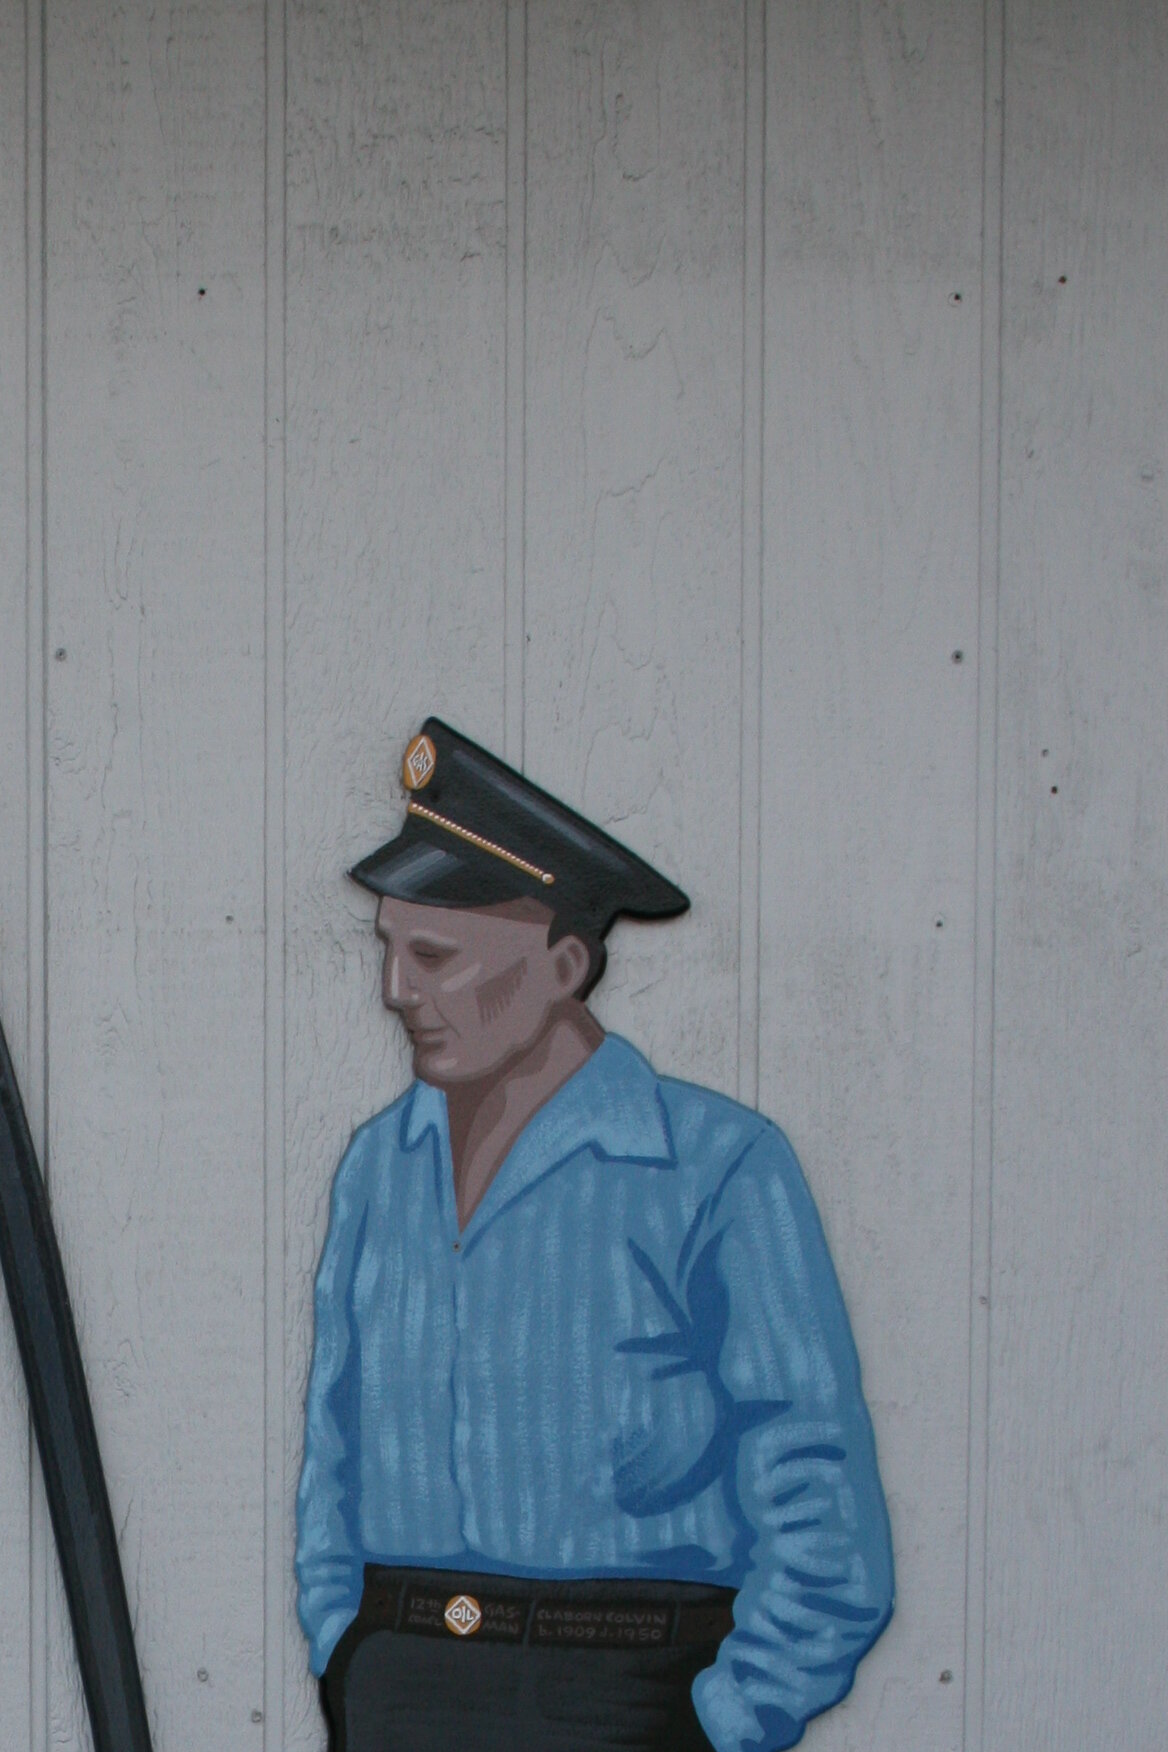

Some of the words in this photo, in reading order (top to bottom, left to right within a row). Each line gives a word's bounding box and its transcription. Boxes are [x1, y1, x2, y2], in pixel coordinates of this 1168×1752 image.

[451, 1606, 474, 1623] OIL
[536, 1609, 603, 1622] CLABORN
[605, 1611, 667, 1625] COLVIN
[482, 1620, 519, 1635] MAN
[557, 1625, 596, 1638] 1909
[617, 1628, 662, 1641] 1950
